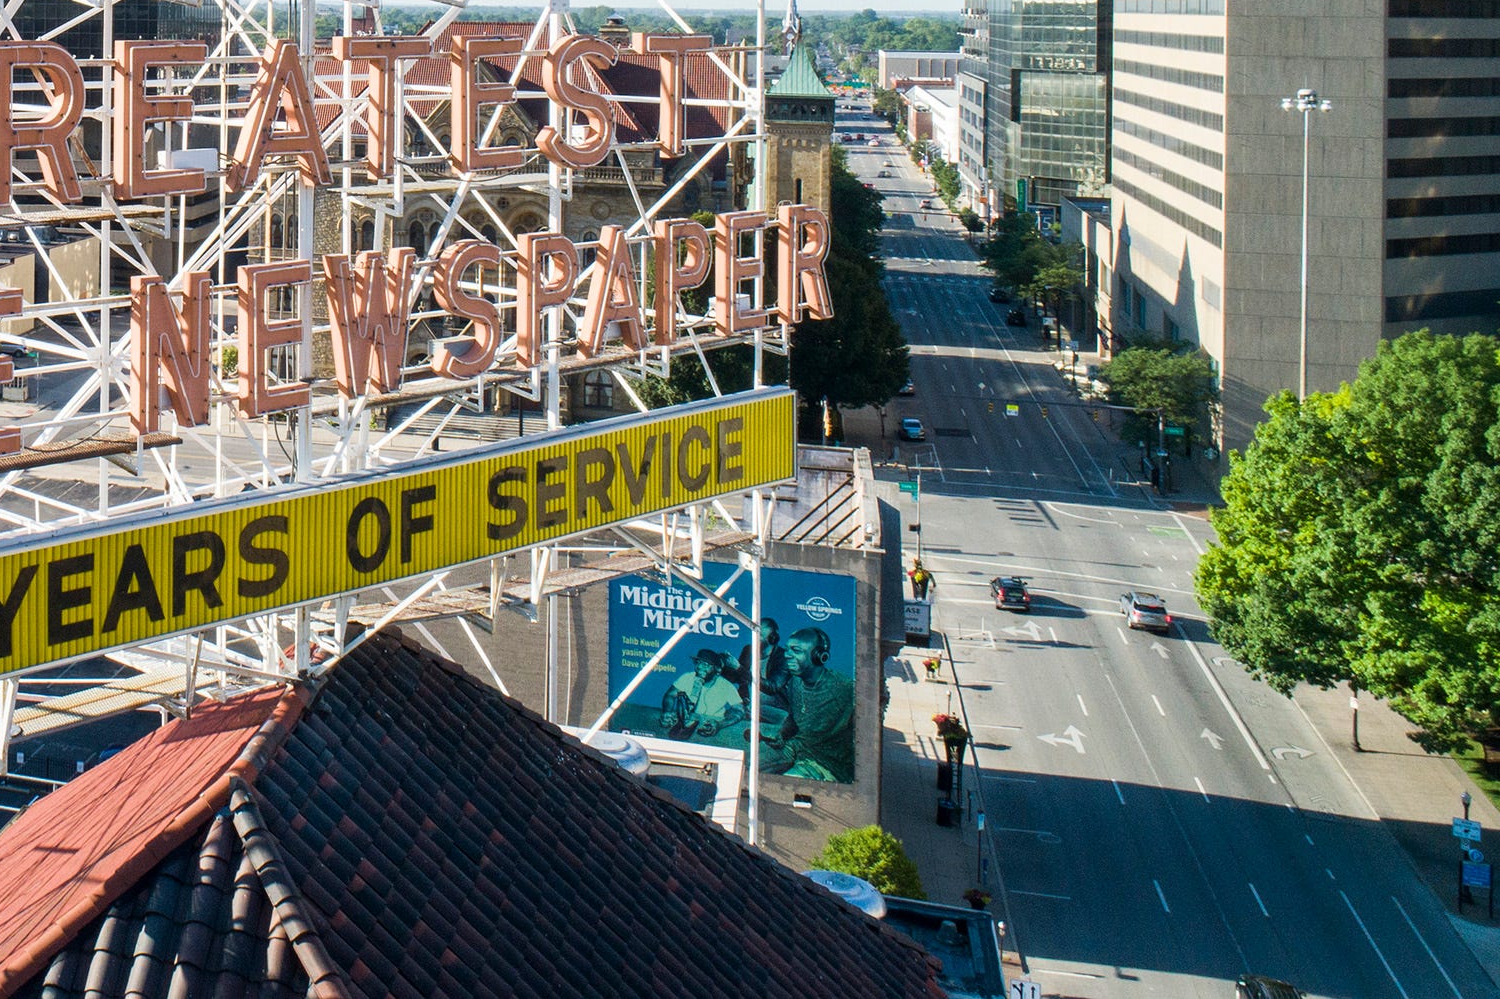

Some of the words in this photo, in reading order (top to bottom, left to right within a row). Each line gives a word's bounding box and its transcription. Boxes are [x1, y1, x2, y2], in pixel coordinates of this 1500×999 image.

[130, 202, 836, 436] NEWSPAPER
[347, 485, 436, 573] OF
[487, 416, 745, 541] SERVICE
[667, 586, 684, 595] The
[621, 636, 639, 646] Talib
[640, 638, 660, 648] Kweli
[644, 650, 656, 659] be
[621, 659, 639, 668] Dave
[640, 660, 677, 673] Cppelle
